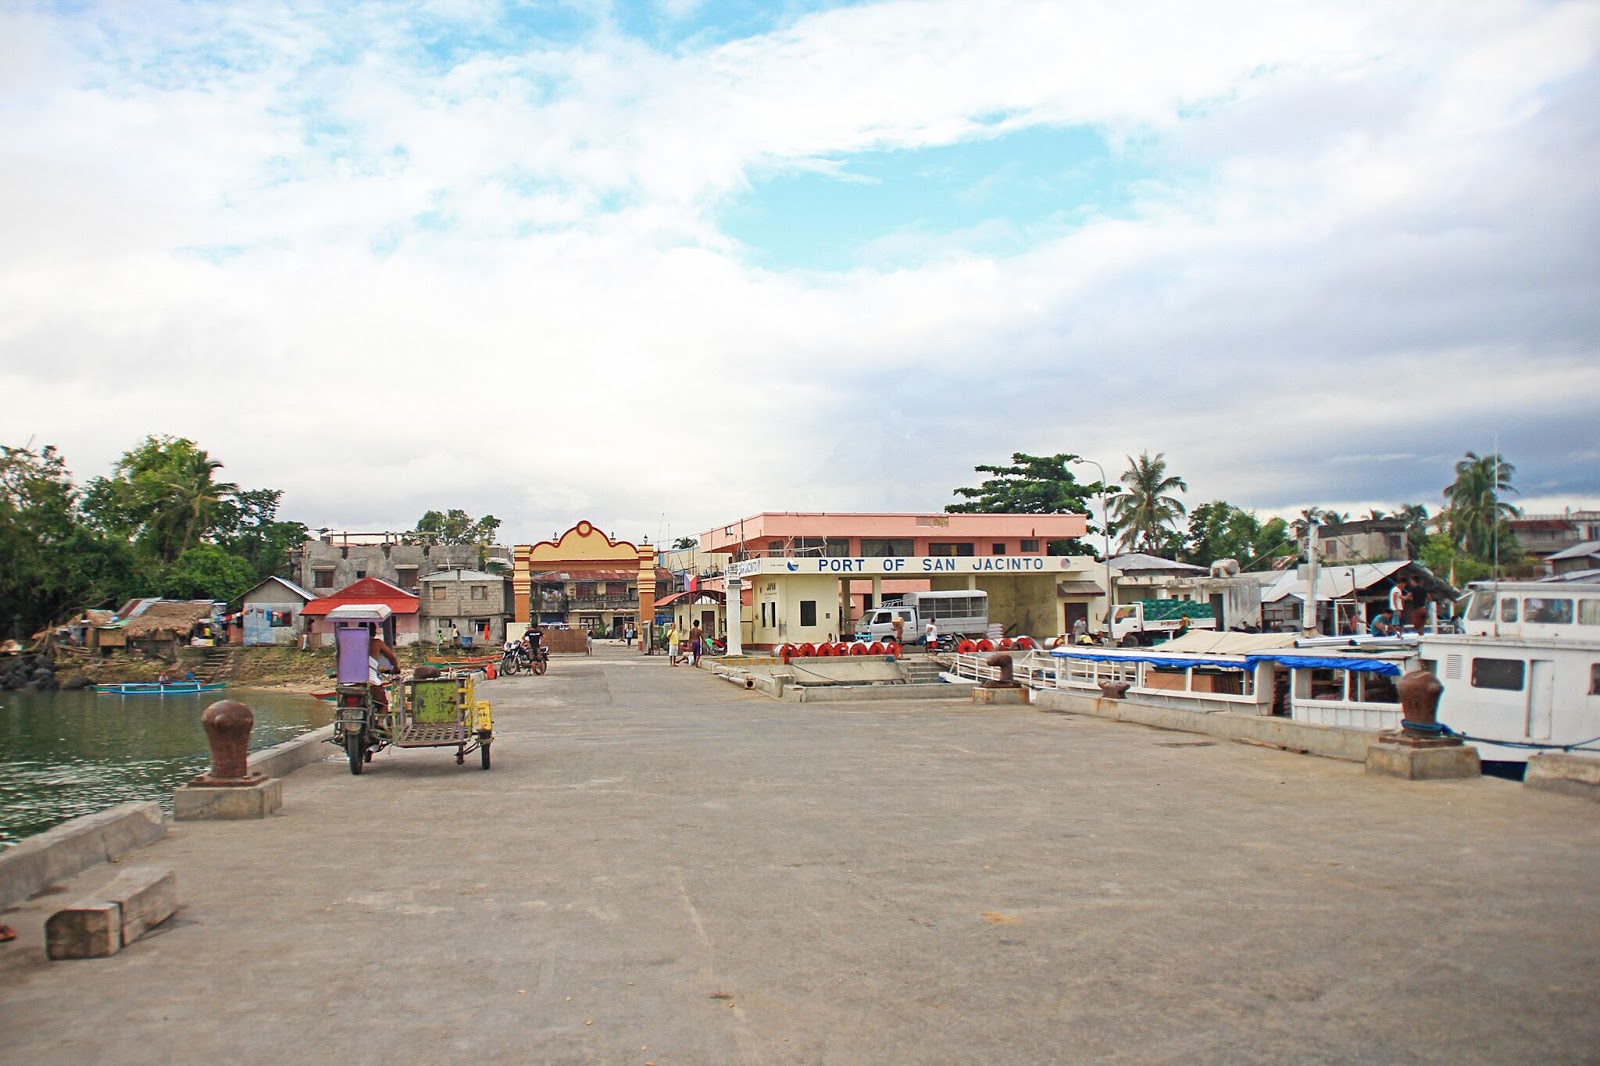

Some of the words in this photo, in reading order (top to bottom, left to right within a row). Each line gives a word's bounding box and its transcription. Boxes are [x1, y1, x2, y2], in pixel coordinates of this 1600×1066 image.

[818, 559, 865, 571] PORT
[883, 559, 905, 571] OF
[923, 559, 955, 571] SAN
[972, 558, 1043, 570] JACINTO
